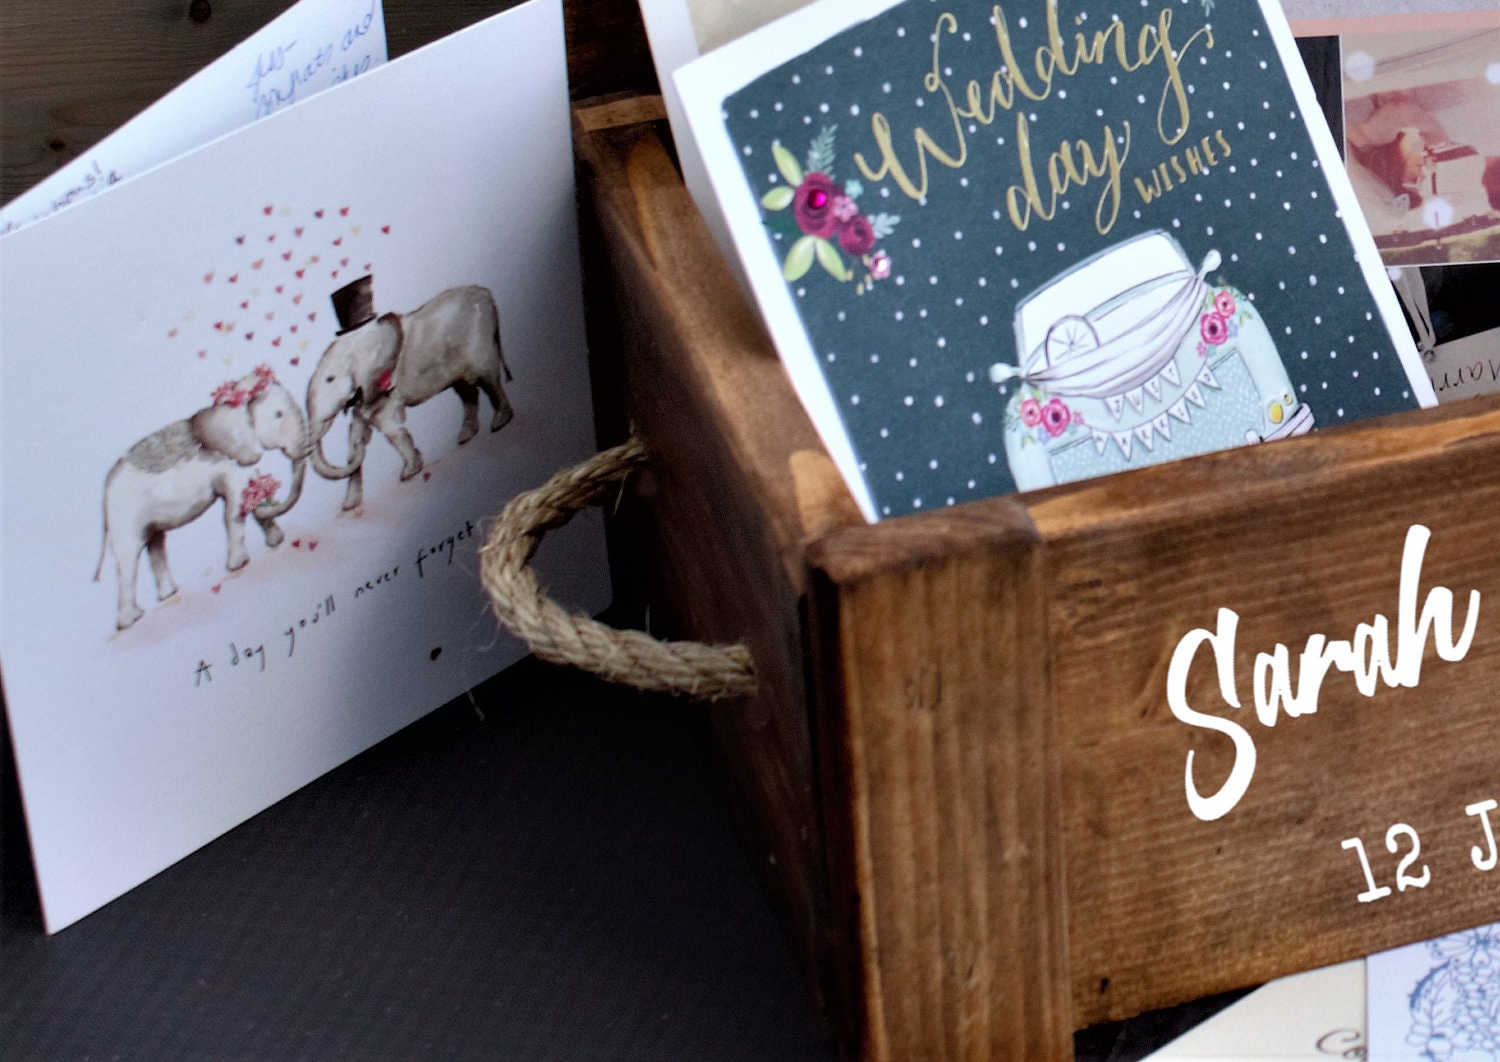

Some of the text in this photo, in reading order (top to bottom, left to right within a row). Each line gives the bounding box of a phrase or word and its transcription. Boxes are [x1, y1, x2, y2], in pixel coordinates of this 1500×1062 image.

[1006, 112, 1131, 235] day
[1135, 129, 1233, 205] WISHES
[195, 520, 475, 687] A day you'll never forget
[1166, 524, 1481, 821] Sarah
[1341, 823, 1431, 902] 12
